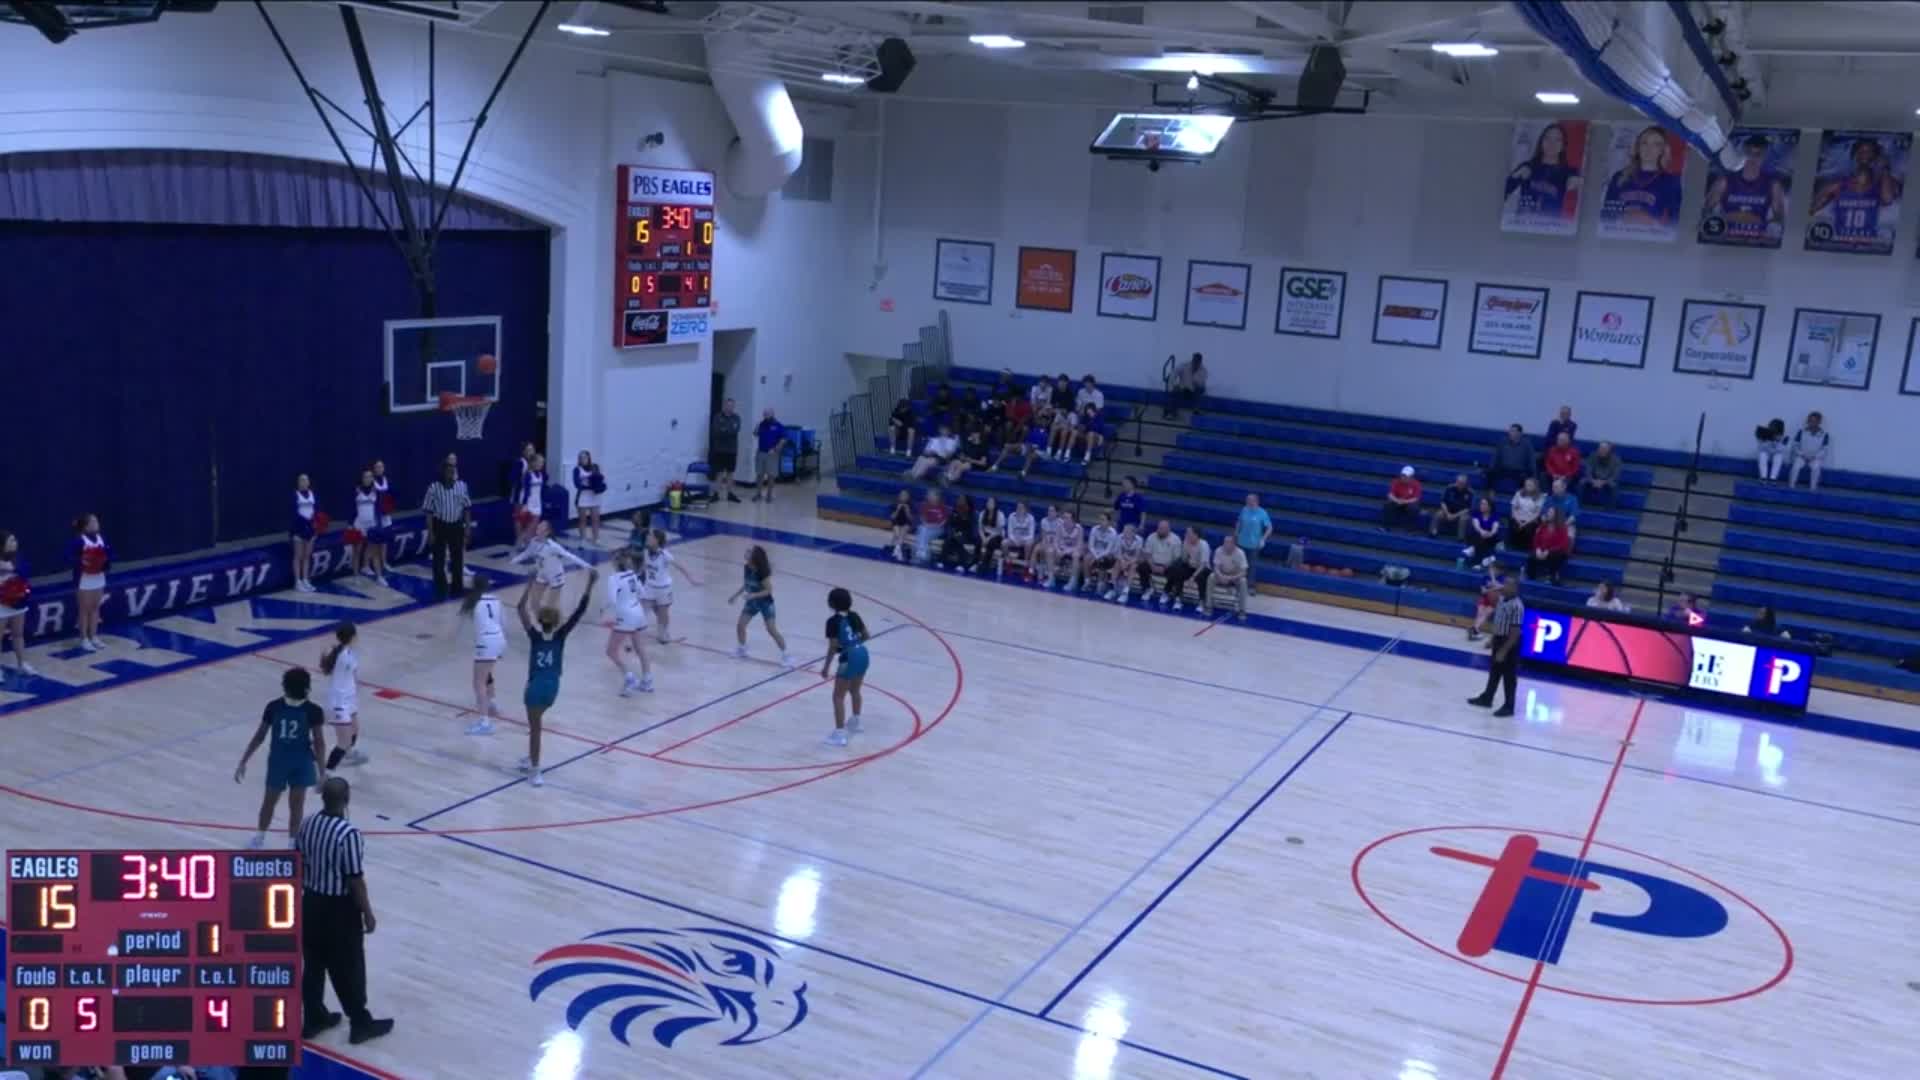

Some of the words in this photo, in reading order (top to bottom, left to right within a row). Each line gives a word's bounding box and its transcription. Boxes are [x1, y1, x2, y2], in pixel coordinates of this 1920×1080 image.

[633, 175, 659, 195] PBS
[661, 179, 712, 196] EAGLES
[662, 206, 691, 229] 3:40
[703, 222, 712, 244] 0
[631, 276, 640, 293] 0
[647, 275, 654, 293] 5
[685, 276, 693, 290] 4
[670, 320, 708, 335] ZERO
[486, 603, 493, 620] 1
[536, 651, 554, 668] 24
[279, 719, 298, 739] 12
